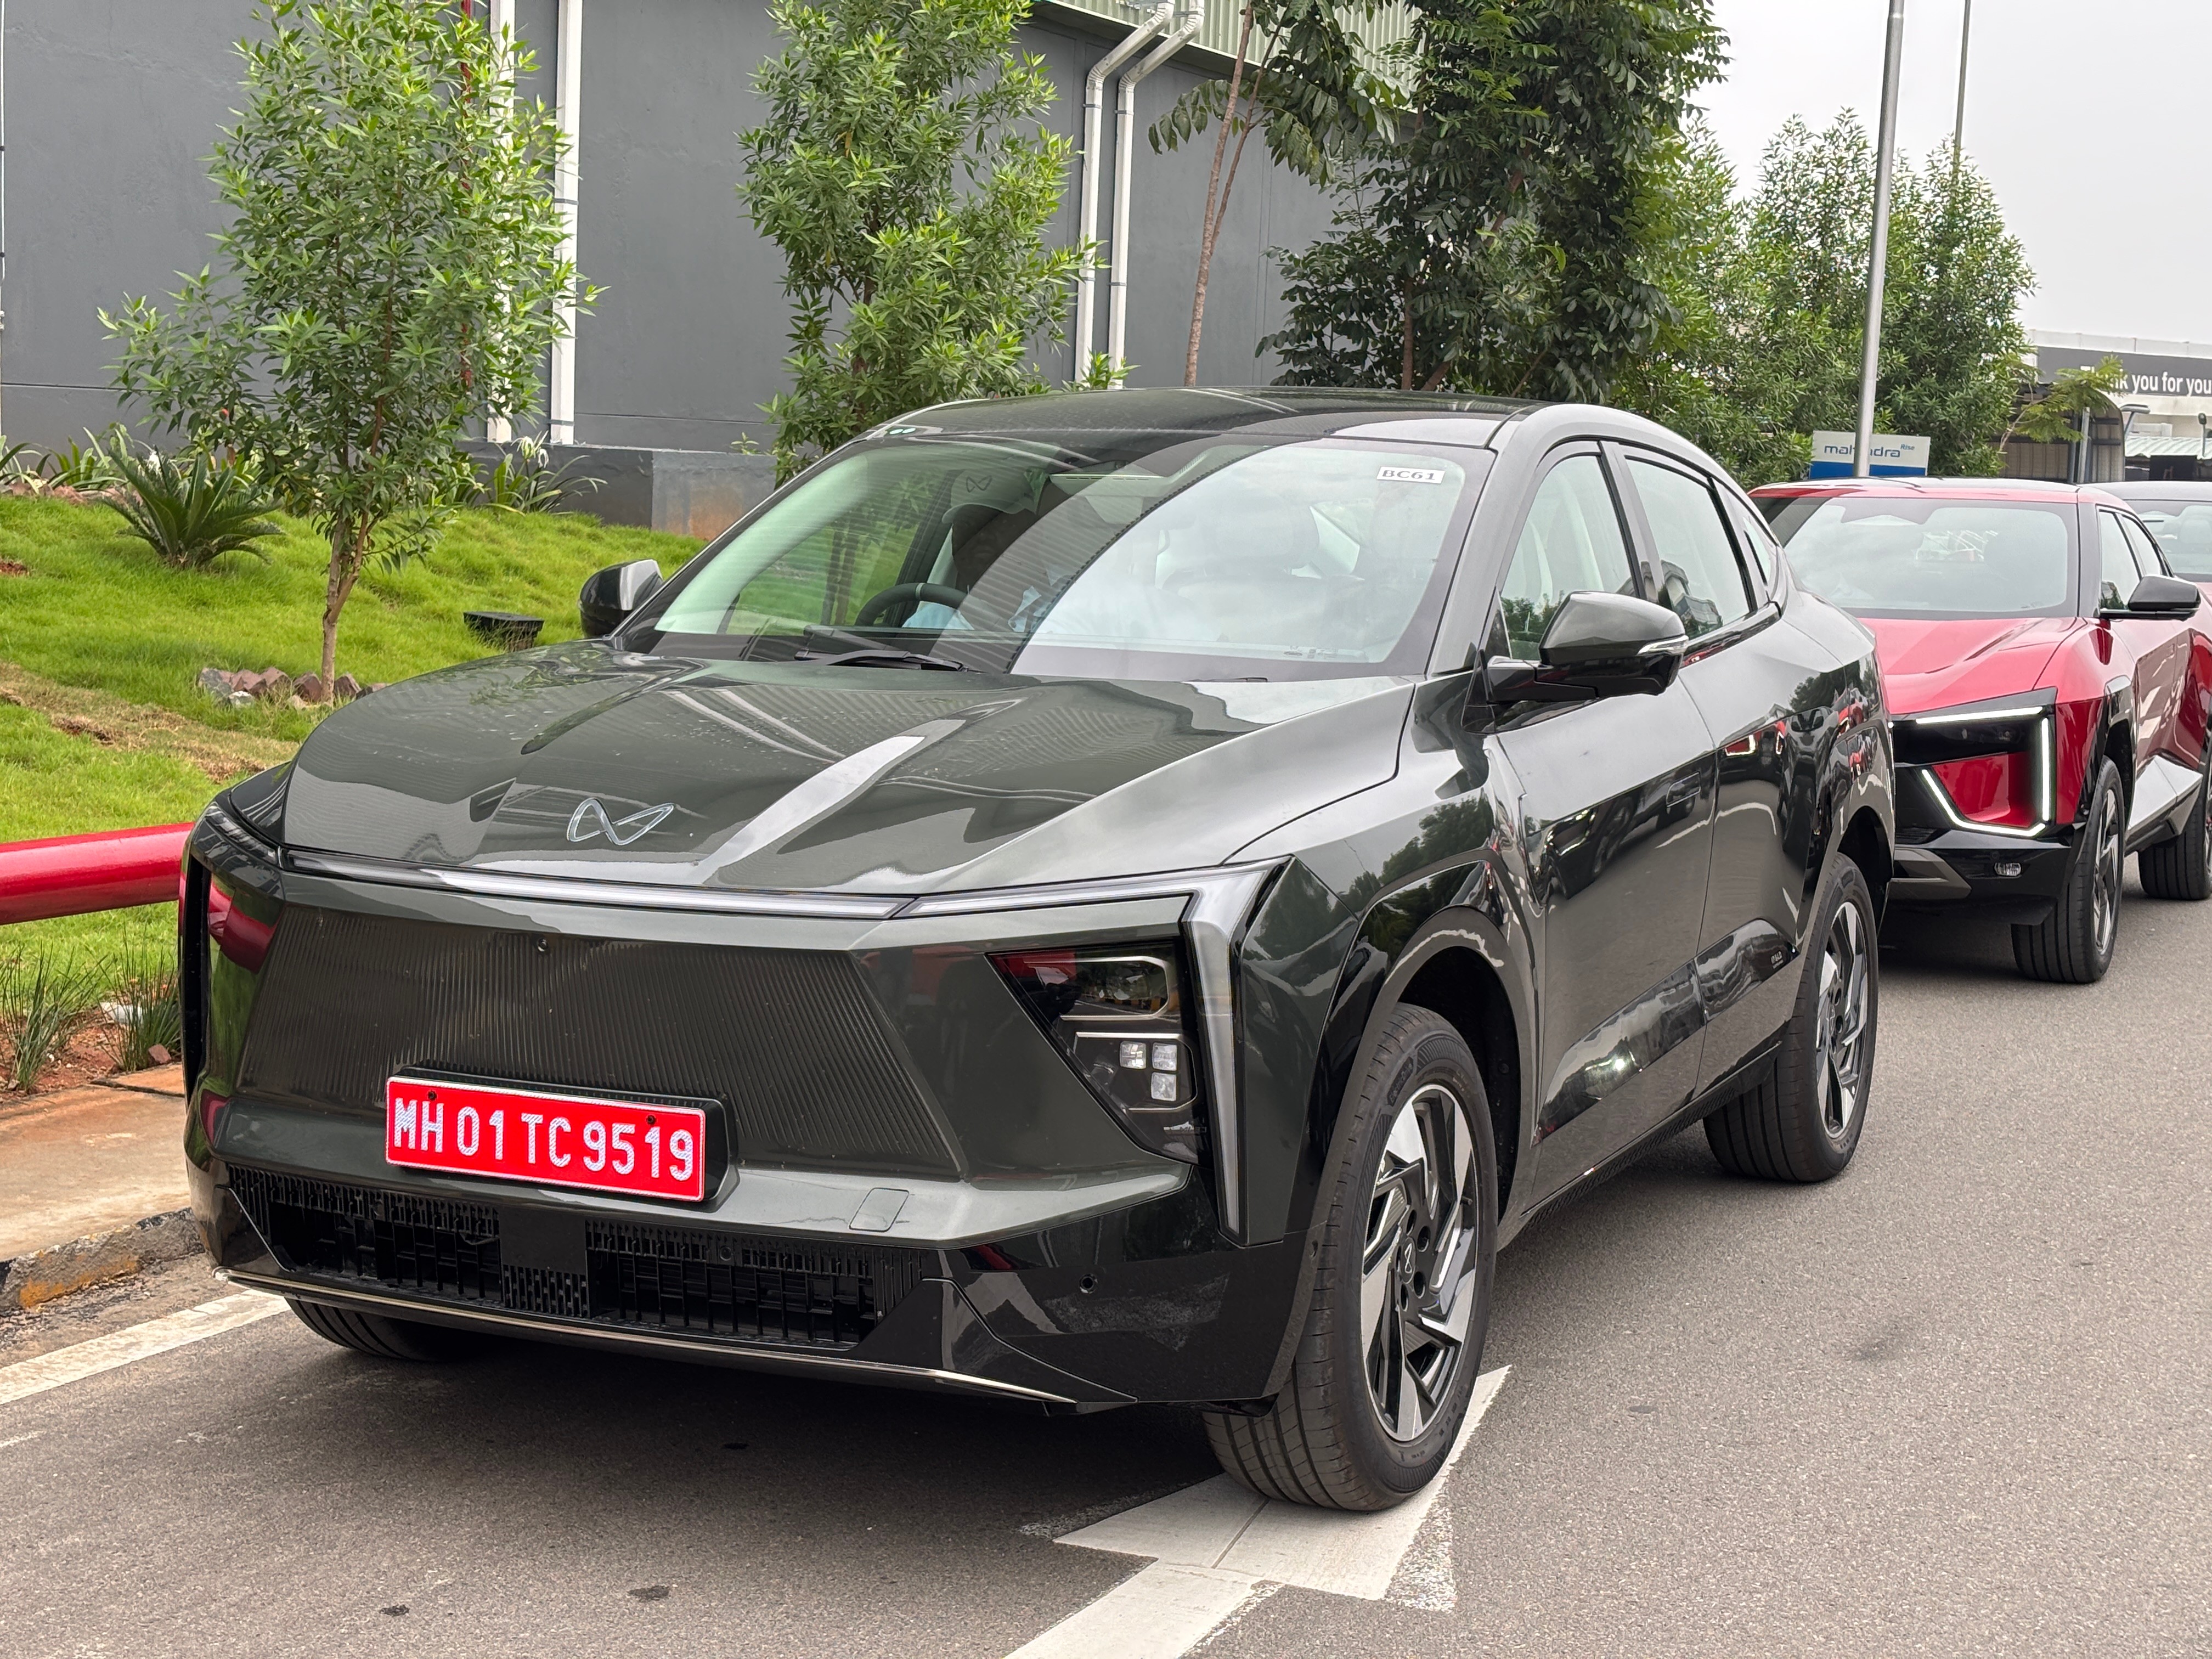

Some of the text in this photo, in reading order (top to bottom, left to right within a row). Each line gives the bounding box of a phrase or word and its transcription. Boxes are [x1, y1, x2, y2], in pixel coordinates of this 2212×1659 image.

[2132, 375, 2158, 394] you
[2162, 371, 2183, 393] for
[1382, 470, 1436, 480] BC61
[393, 1097, 695, 1182] MH 01 TC 9519
